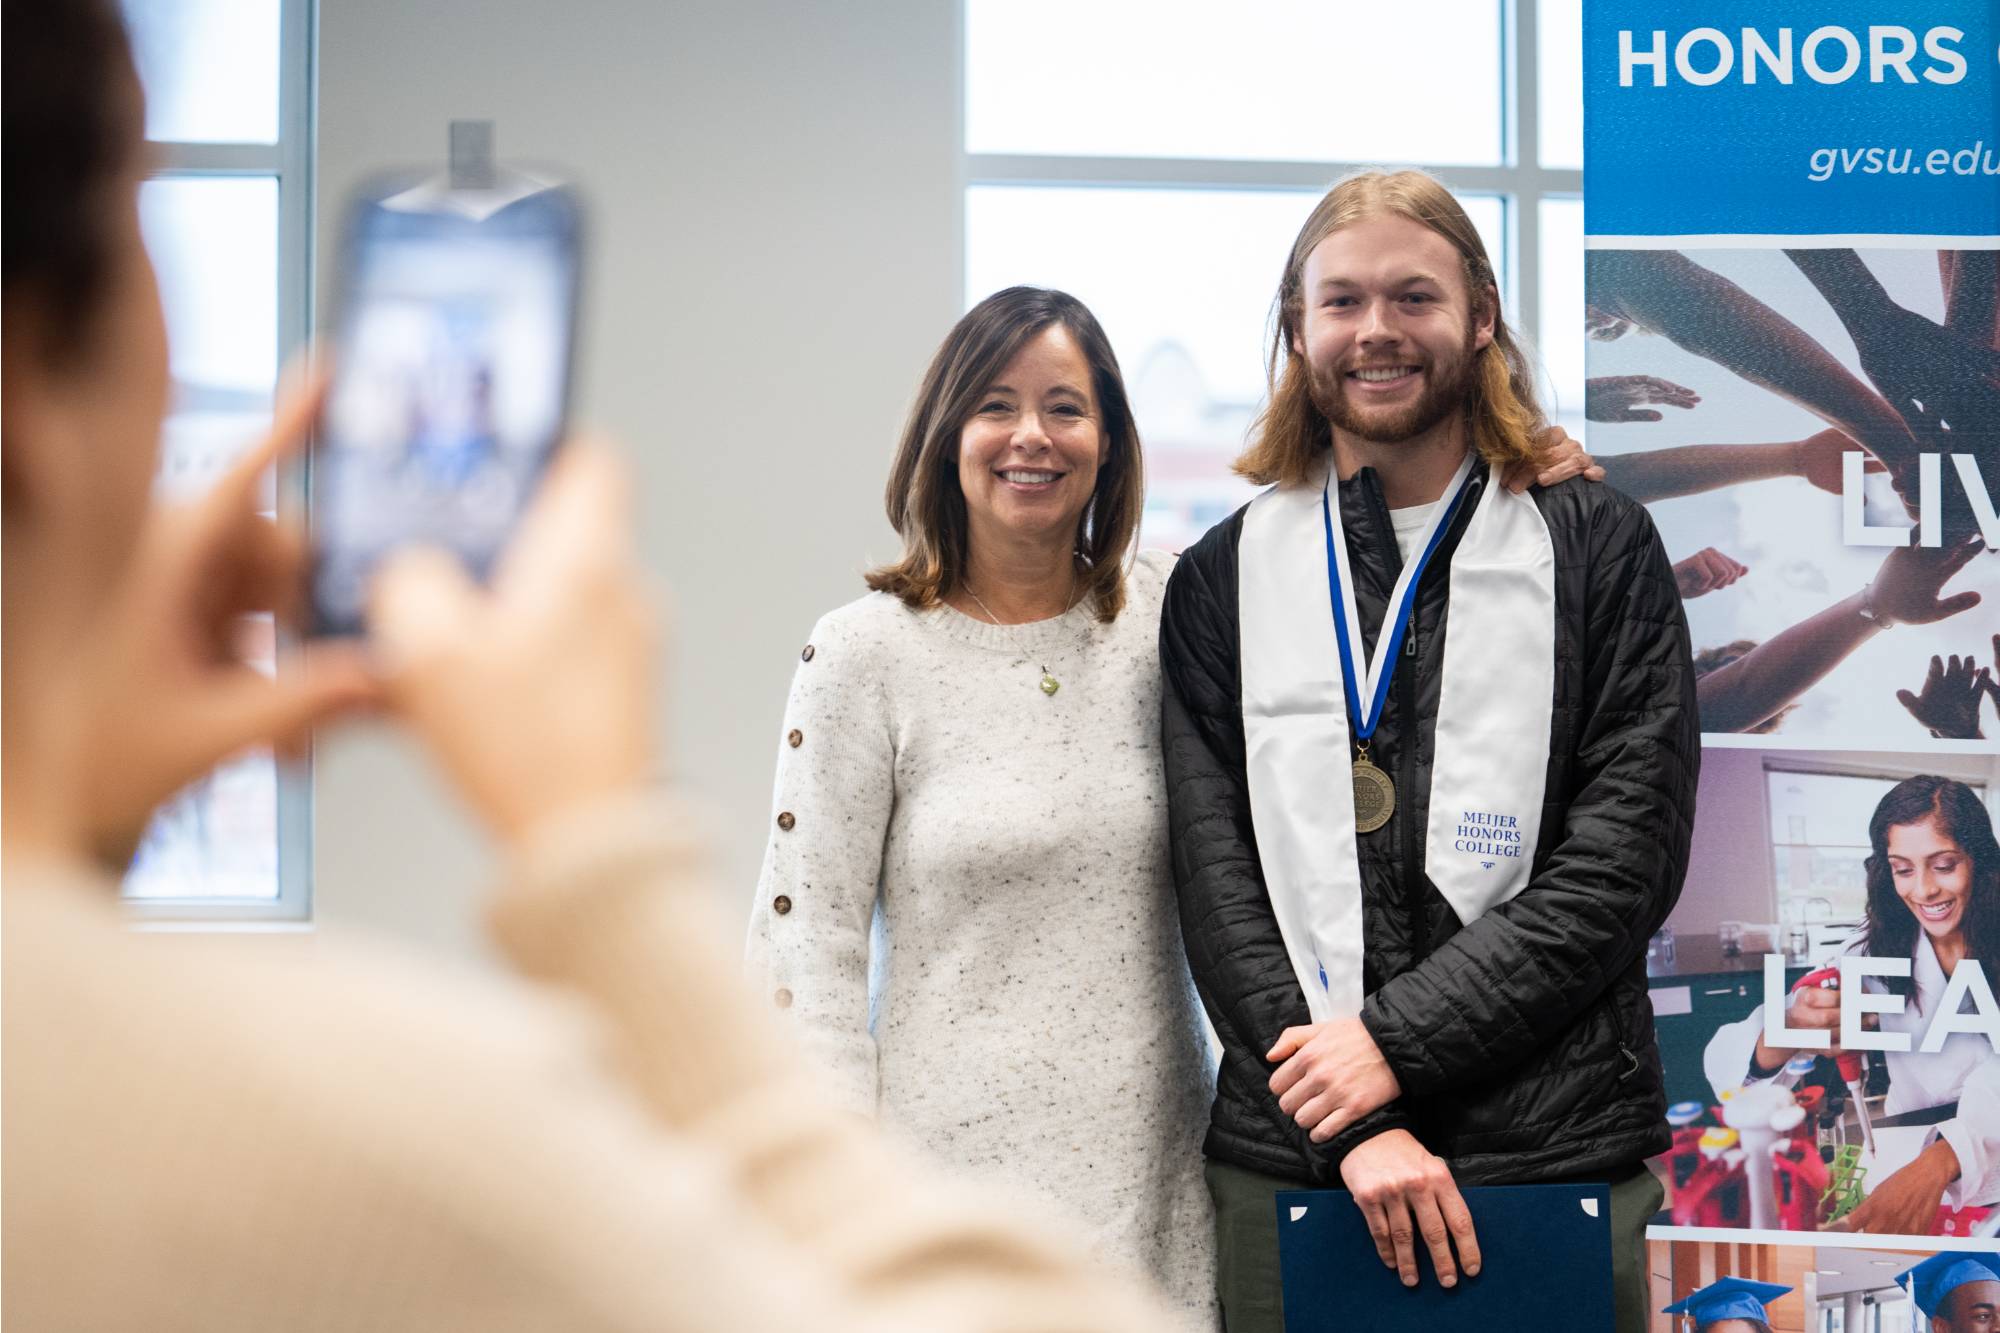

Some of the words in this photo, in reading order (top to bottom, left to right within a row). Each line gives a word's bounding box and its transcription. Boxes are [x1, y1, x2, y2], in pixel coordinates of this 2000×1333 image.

[1618, 25, 1968, 87] HONORS
[1463, 811, 1518, 828] MEIJER
[1457, 825, 1521, 843] HONORS
[1455, 839, 1521, 858] COLLEGE
[1764, 953, 2000, 1054] LEA
